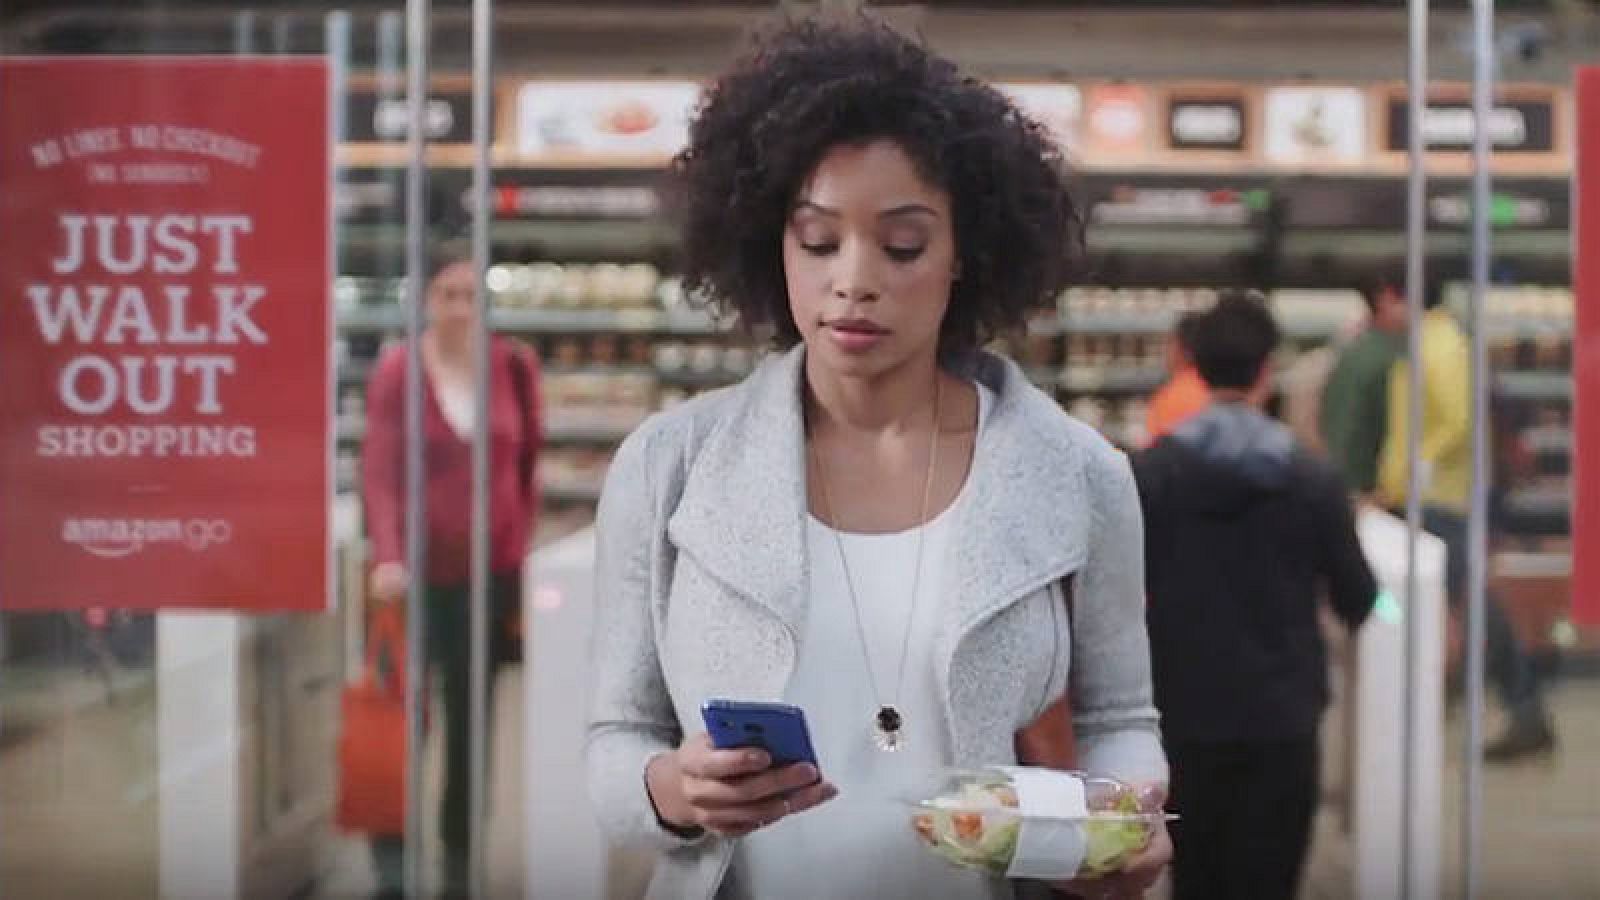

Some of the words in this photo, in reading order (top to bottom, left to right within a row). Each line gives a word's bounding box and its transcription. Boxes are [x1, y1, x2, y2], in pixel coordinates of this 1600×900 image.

[53, 213, 252, 275] JUST
[27, 284, 268, 343] WALK
[58, 354, 235, 415] OUT
[37, 425, 257, 457] SHOPPING
[62, 518, 182, 543] amazon
[185, 518, 232, 550] go
